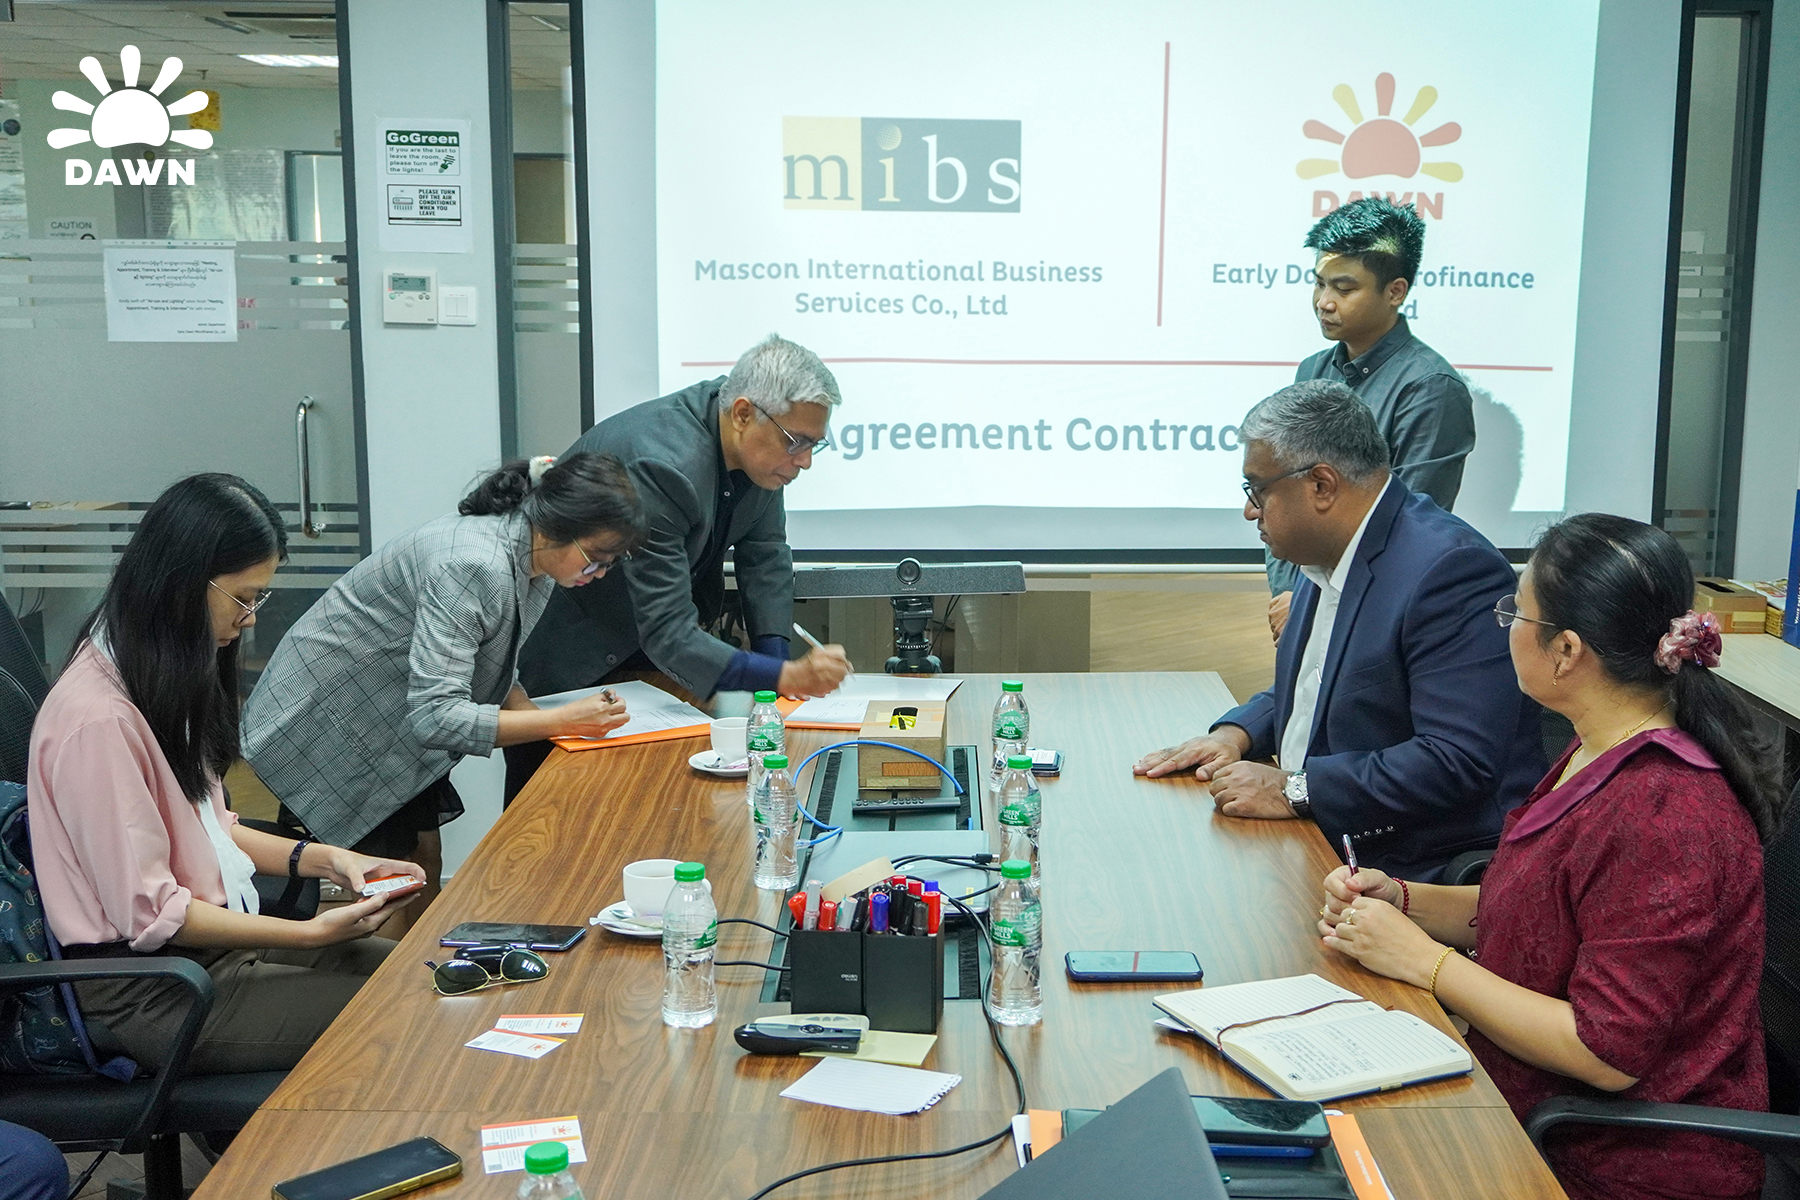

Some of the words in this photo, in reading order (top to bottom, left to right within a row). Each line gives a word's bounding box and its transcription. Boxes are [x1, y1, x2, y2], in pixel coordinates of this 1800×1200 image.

[387, 132, 458, 144] GoGreen
[695, 259, 800, 281] Mascon
[807, 258, 985, 282] International
[992, 261, 1103, 283] Business
[1213, 263, 1278, 289] Early
[1285, 264, 1316, 284] Da
[1413, 266, 1535, 288] rofinance
[795, 292, 904, 315] Services
[911, 294, 958, 320] Co.,
[966, 294, 1008, 316] Ltd
[1066, 417, 1239, 452] Contrac
